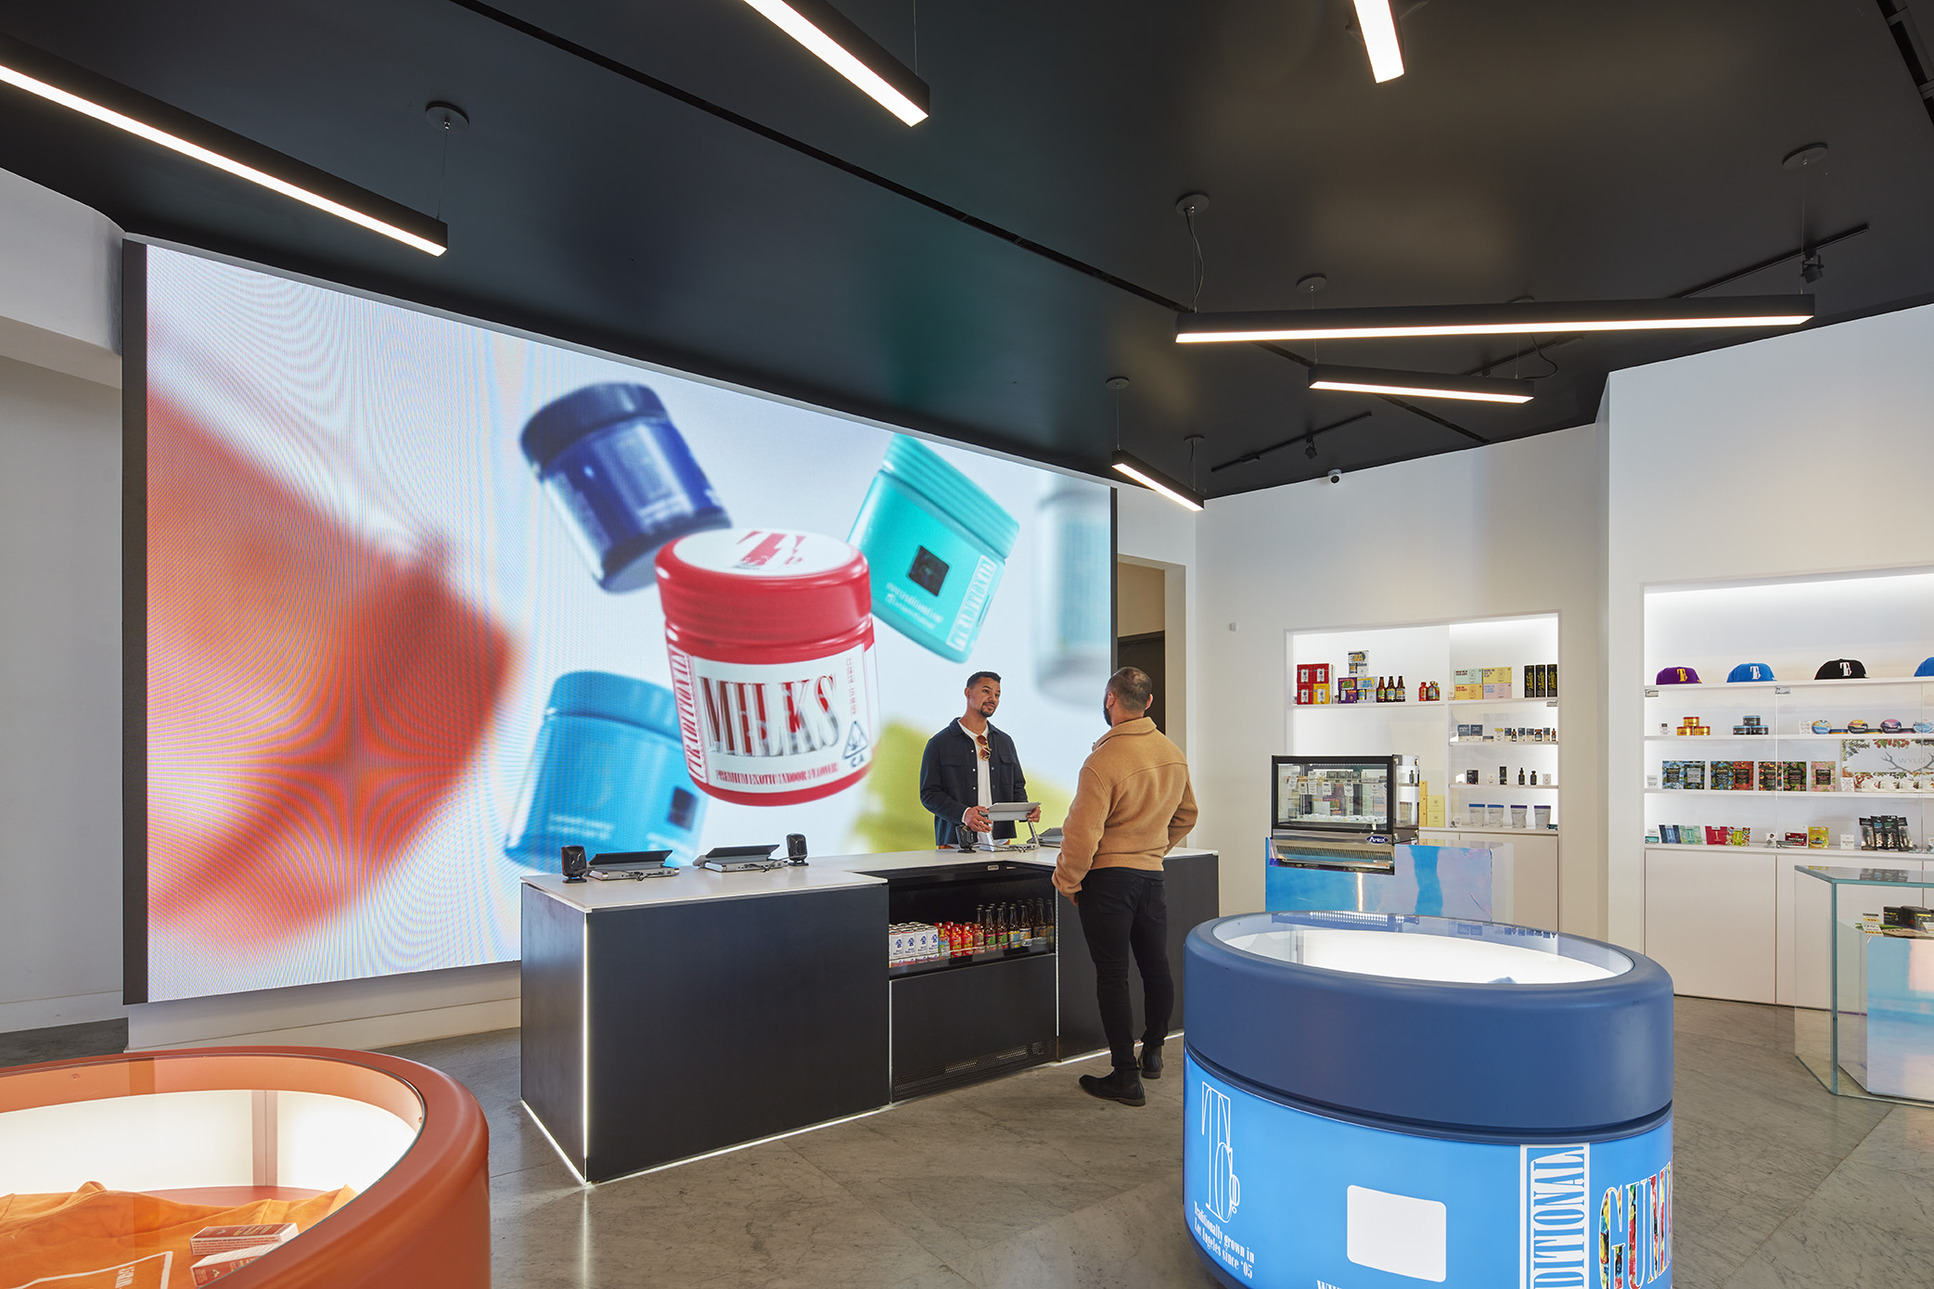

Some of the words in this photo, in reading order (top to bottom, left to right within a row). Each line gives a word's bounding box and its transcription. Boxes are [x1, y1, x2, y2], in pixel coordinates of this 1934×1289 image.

[698, 674, 841, 757] MILKS
[1202, 1226, 1222, 1257] Angeles
[1222, 1249, 1240, 1271] since
[1223, 1234, 1245, 1258] grown
[1246, 1246, 1255, 1264] in
